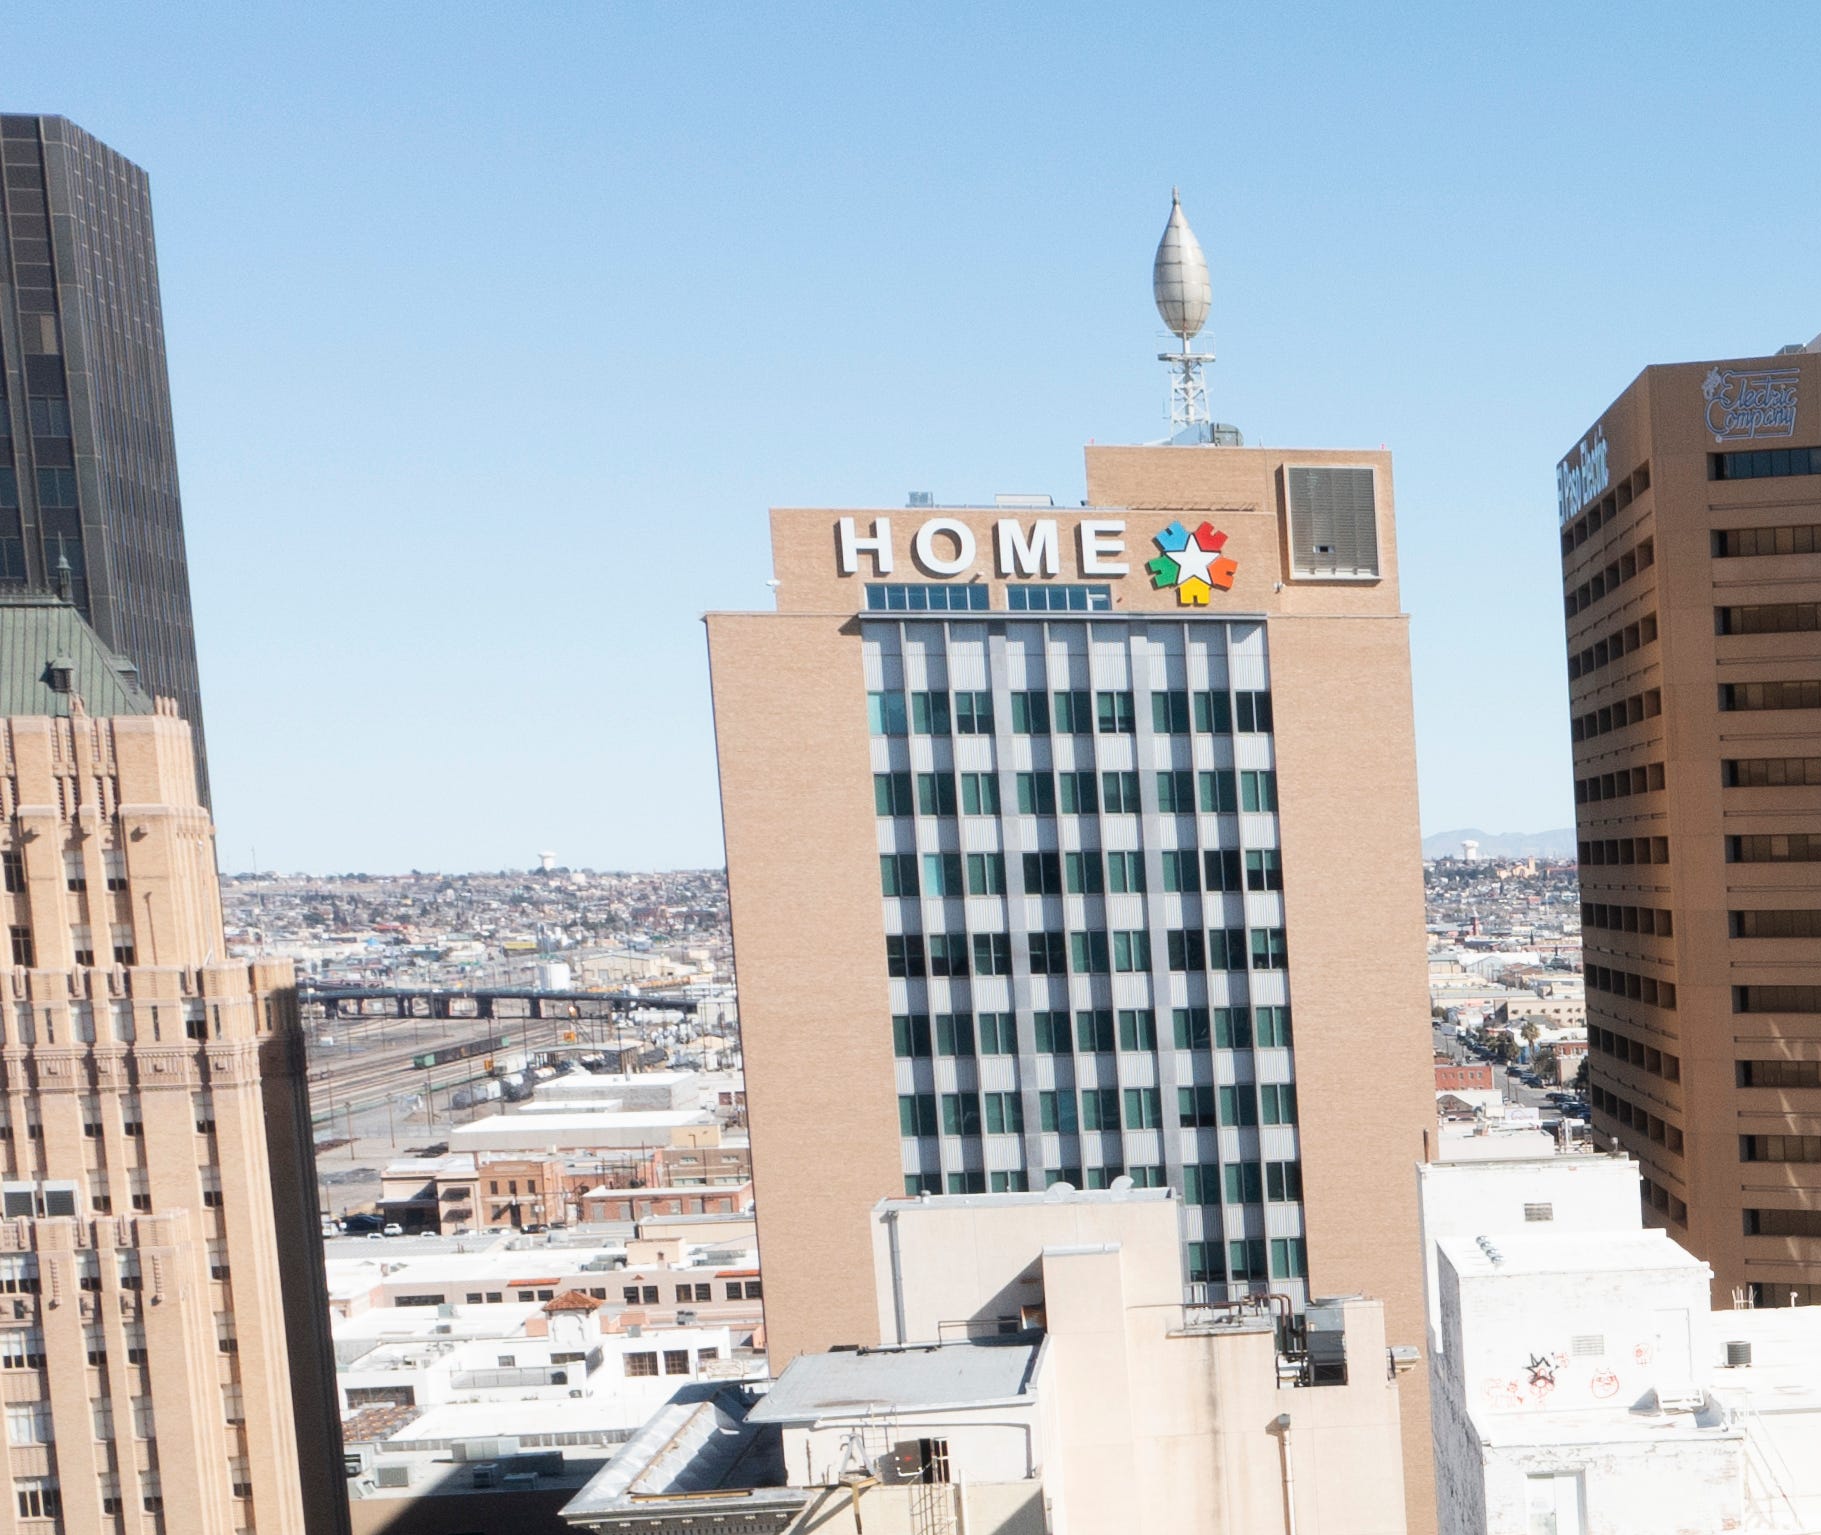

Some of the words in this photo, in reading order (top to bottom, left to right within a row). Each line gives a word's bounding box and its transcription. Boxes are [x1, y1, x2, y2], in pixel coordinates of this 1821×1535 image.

[1719, 369, 1800, 411] Electric
[1705, 397, 1797, 441] Company
[1580, 425, 1609, 506] Electric
[838, 516, 1130, 576] HOME
